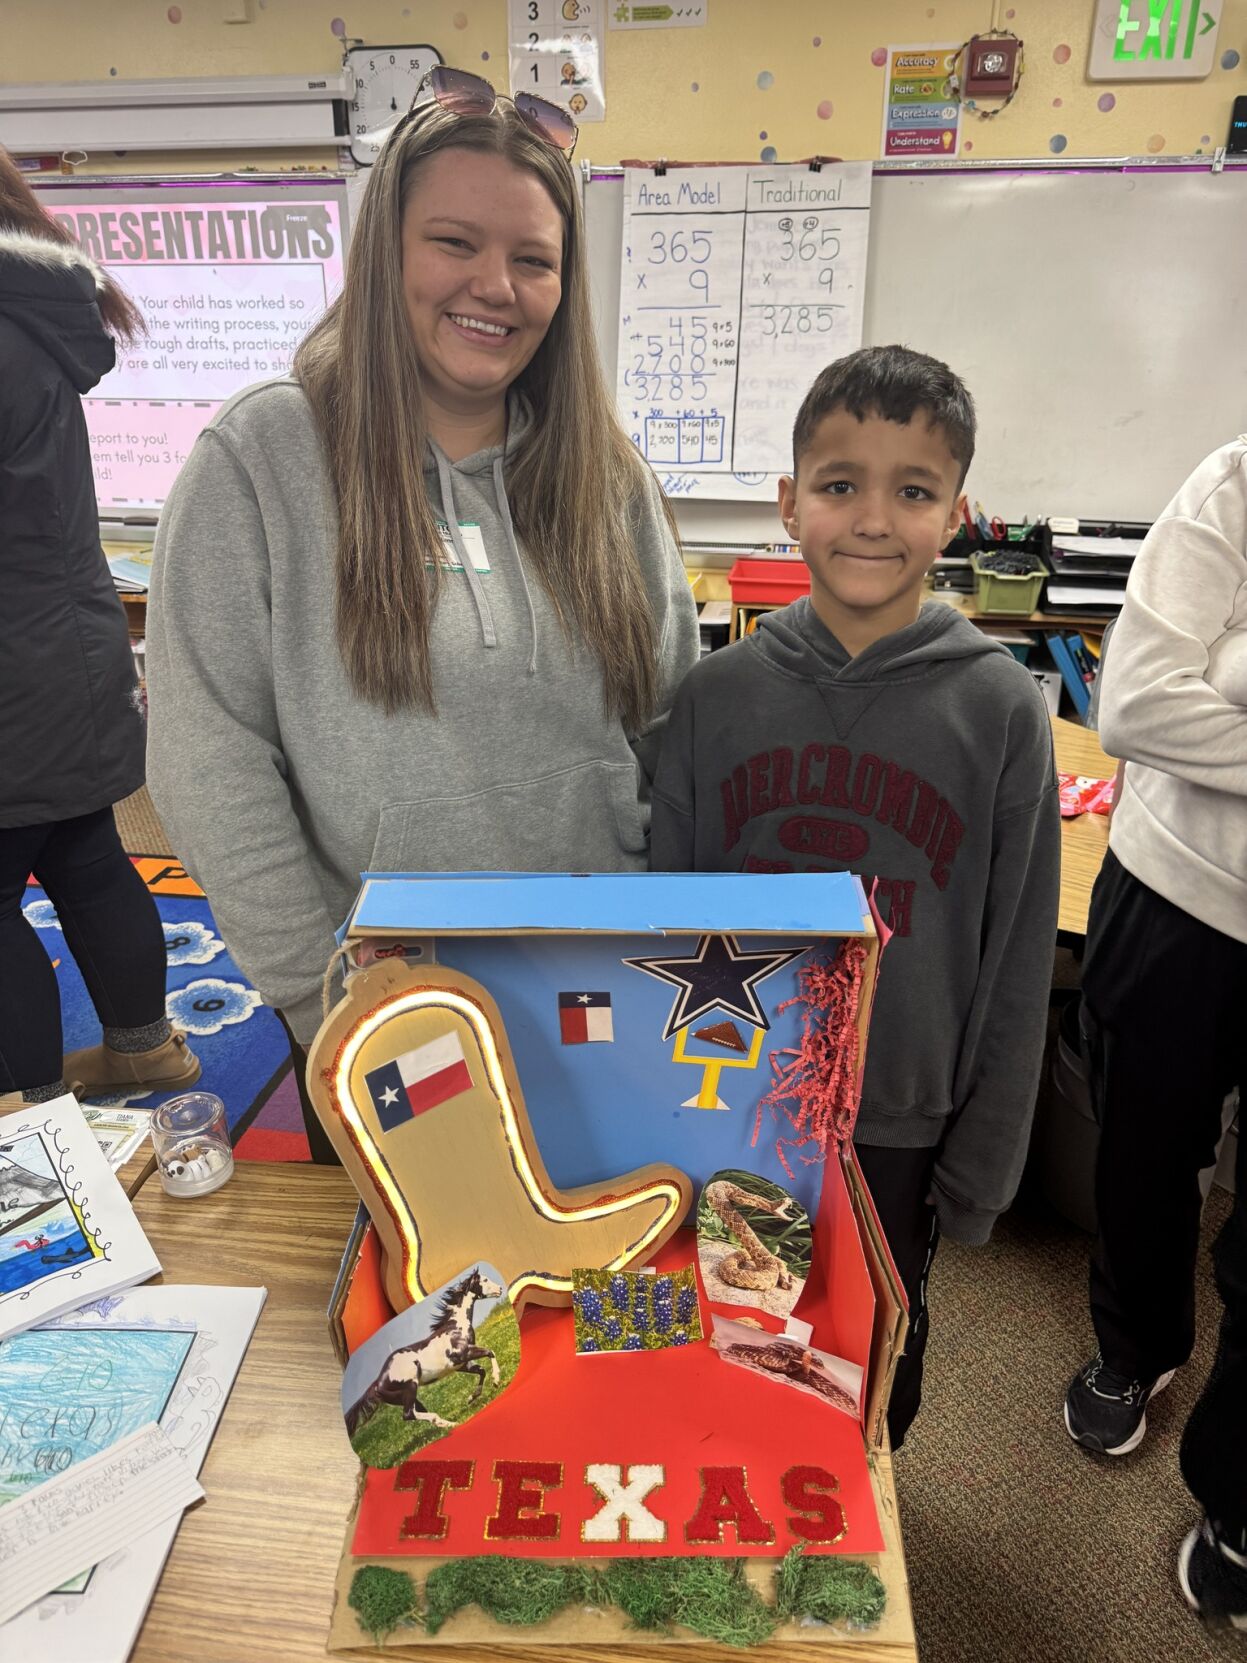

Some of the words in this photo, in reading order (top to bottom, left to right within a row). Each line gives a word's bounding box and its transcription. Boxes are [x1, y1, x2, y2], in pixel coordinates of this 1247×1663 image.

[528, 1, 539, 21] 3
[528, 32, 540, 52] 2
[369, 61, 376, 71] 5
[389, 55, 396, 65] 0
[410, 60, 420, 70] 55
[896, 57, 938, 68] Accuracy
[530, 63, 539, 82] 1
[355, 79, 364, 89] 10
[893, 84, 915, 95] Rate
[352, 102, 360, 112] 15
[892, 108, 940, 120] Expression
[356, 125, 367, 134] 20
[889, 136, 941, 147] Understand
[638, 183, 672, 206] Area
[677, 181, 721, 205] Model
[753, 179, 843, 204] Traditional
[648, 230, 713, 264] 365
[780, 229, 842, 261] 365
[689, 269, 709, 303] 9
[818, 268, 834, 294] 9
[139, 296, 169, 309] Your
[172, 294, 205, 309] child
[208, 294, 233, 309] has
[236, 294, 286, 309] worked
[289, 299, 305, 309] so
[149, 315, 171, 329] the
[174, 317, 220, 334] writing
[224, 320, 280, 334] process,
[669, 316, 708, 338] 45
[762, 305, 834, 339] 3,285
[145, 336, 183, 353] rough
[186, 336, 229, 351] drafts,
[233, 337, 297, 355] practiced
[647, 336, 707, 356] 540
[127, 360, 149, 369] are
[152, 355, 168, 369] all
[171, 360, 198, 374] very
[202, 356, 250, 370] excited
[254, 358, 268, 370] to
[633, 375, 708, 402] 3,285
[710, 408, 718, 418] 5
[89, 433, 122, 447] eport
[126, 432, 139, 444] to
[142, 433, 168, 448] you!
[631, 432, 641, 448] 9
[681, 434, 700, 447] 540
[705, 434, 719, 446] 45
[115, 450, 135, 462] tell
[137, 454, 160, 467] you
[162, 451, 172, 463] 3
[394, 1458, 849, 1545] TEXAS
